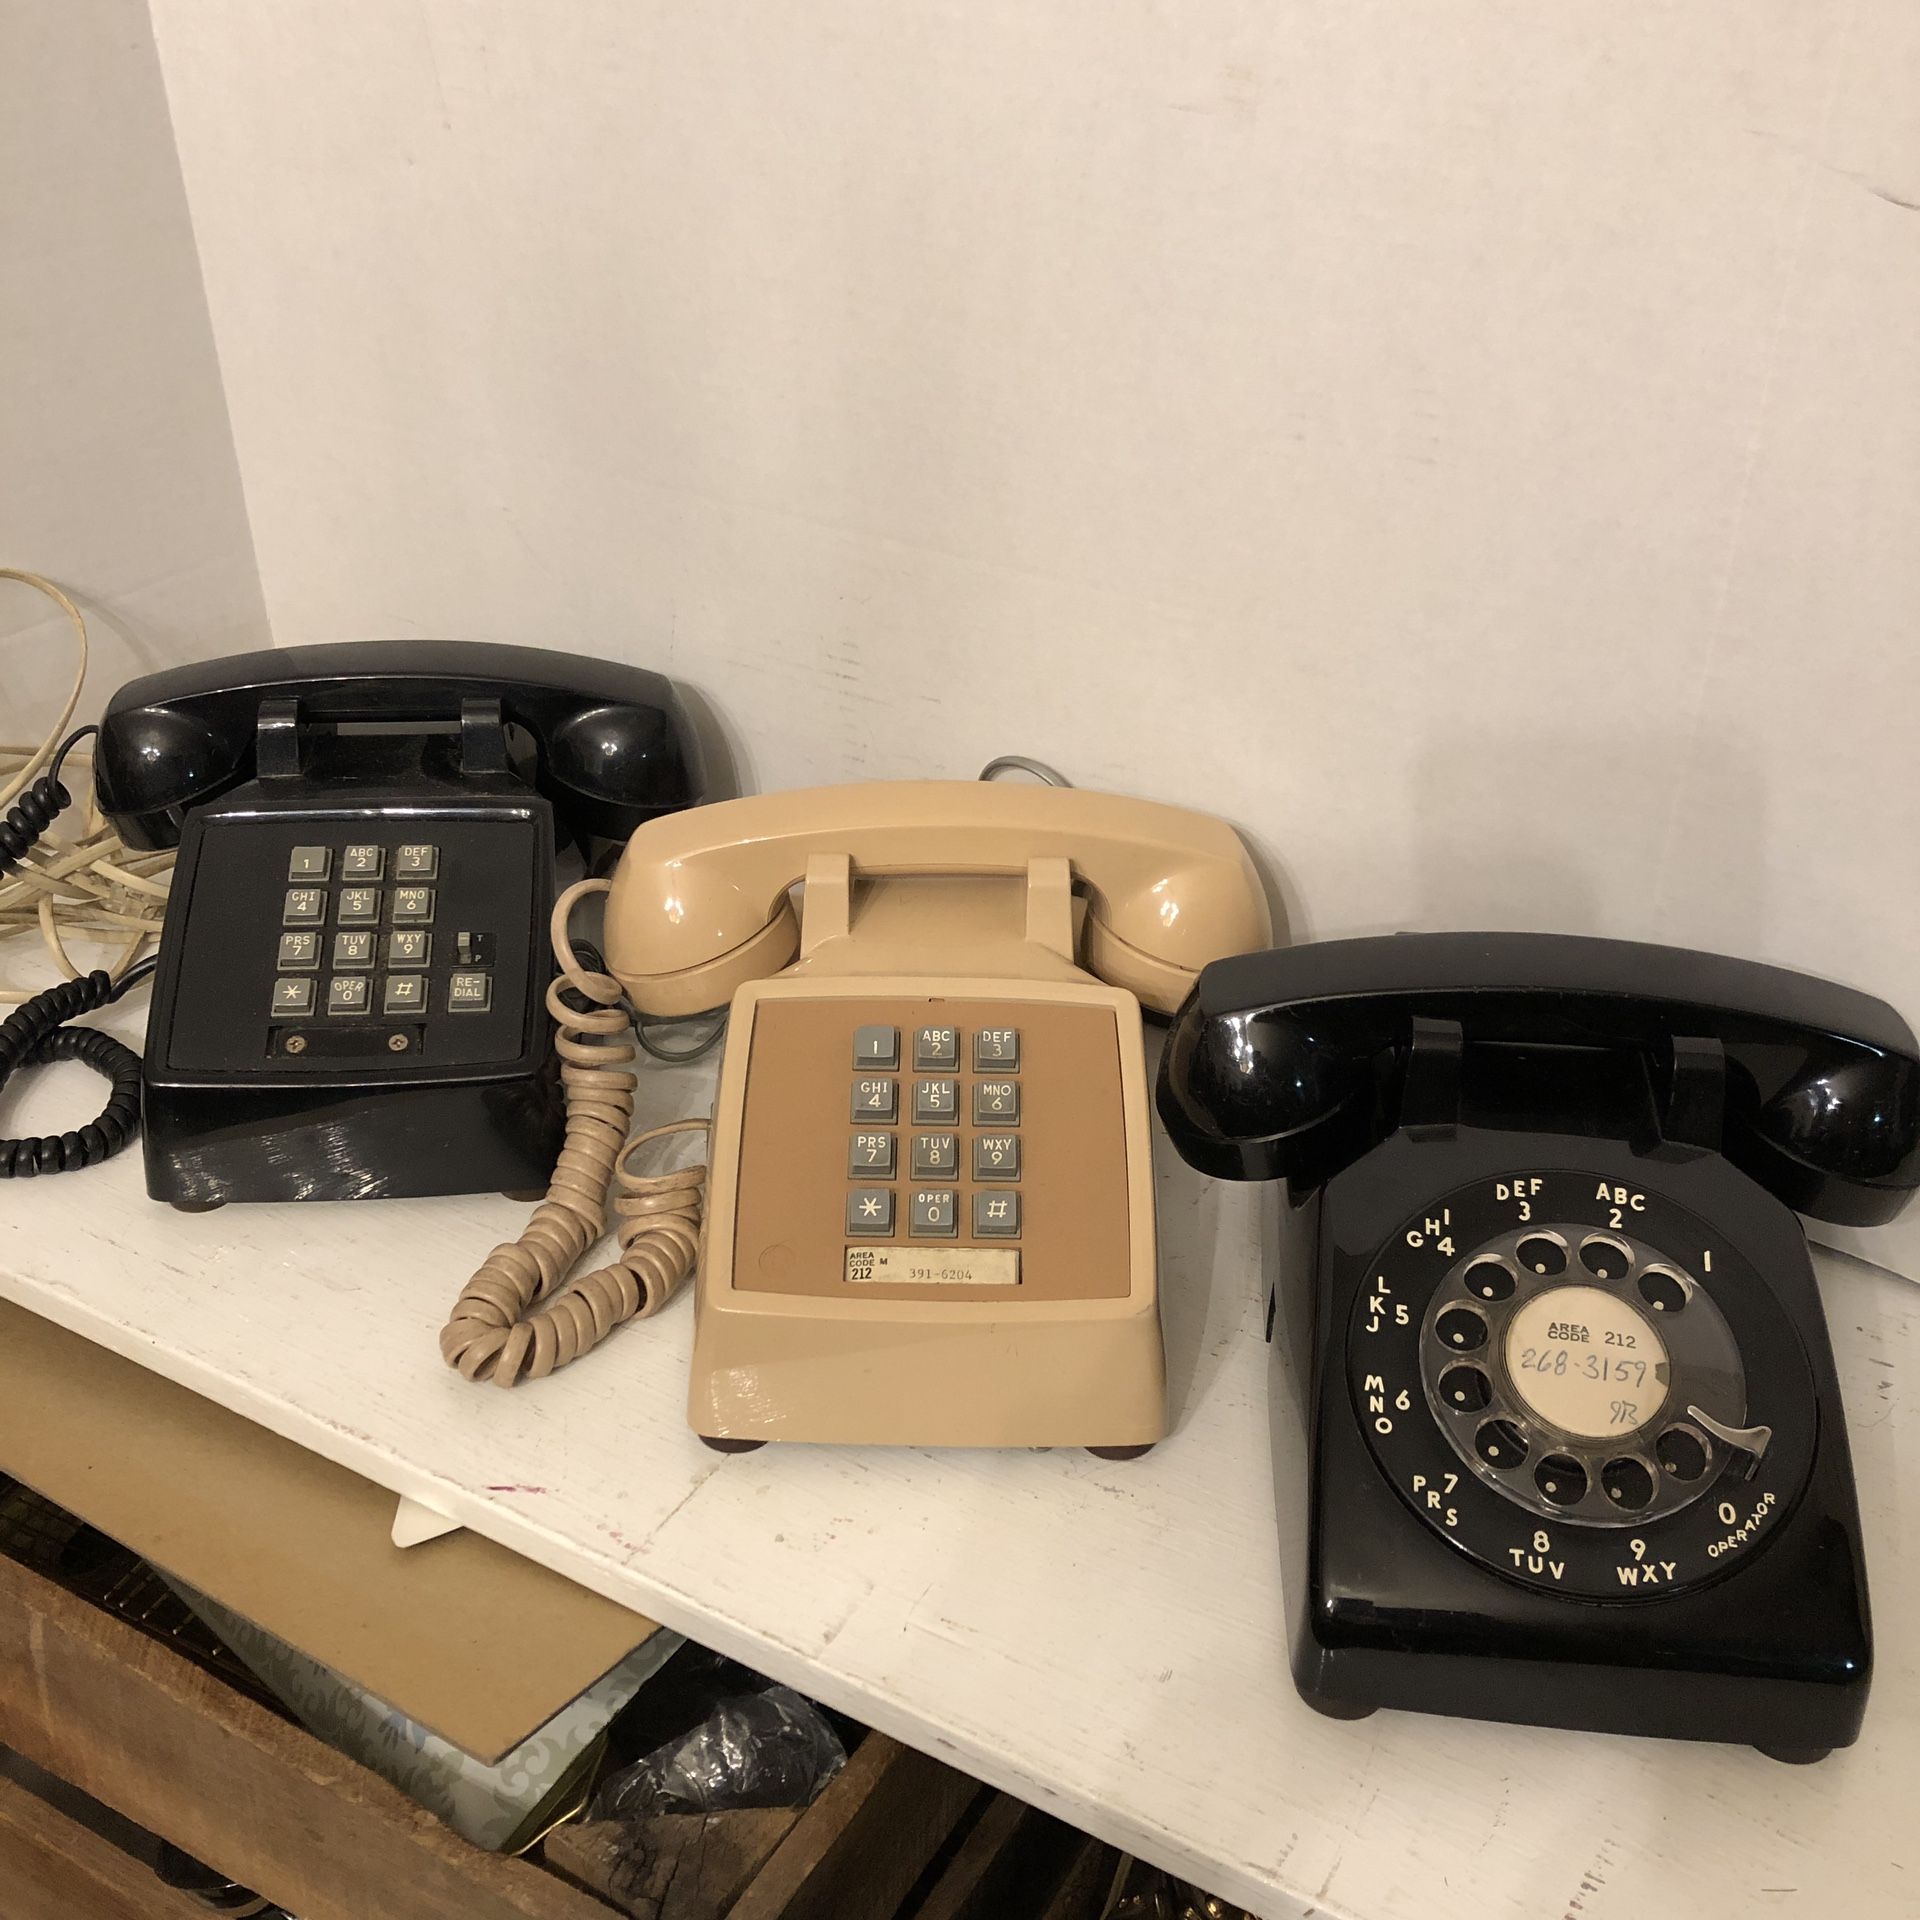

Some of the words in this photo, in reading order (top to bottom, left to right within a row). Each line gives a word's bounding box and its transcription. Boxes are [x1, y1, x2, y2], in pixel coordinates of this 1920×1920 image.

[350, 848, 373, 857] ABC
[404, 847, 428, 856] DEF
[304, 859, 309, 868] 1
[357, 858, 365, 867] 2
[412, 857, 420, 867] 3
[292, 892, 315, 901] GHI
[346, 891, 370, 900] JKL
[400, 891, 425, 900] MNO
[297, 902, 306, 911] 4
[353, 901, 362, 910] 5
[407, 900, 416, 909] 6
[286, 936, 310, 945] PRS
[342, 936, 367, 945] TUV
[397, 934, 422, 943] WXY
[293, 946, 302, 955] 7
[348, 946, 357, 955] 8
[404, 944, 413, 954] 9
[334, 981, 364, 992] OPER
[395, 982, 413, 995] #
[456, 978, 480, 987] RE-
[343, 991, 352, 1001] 0
[454, 988, 480, 997] DIAL
[922, 1030, 950, 1041] ABC
[983, 1031, 1012, 1042] DEF
[873, 1040, 878, 1054] 1
[931, 1043, 942, 1056] 2
[993, 1043, 1002, 1056] 3
[861, 1082, 888, 1093] GHI
[922, 1082, 950, 1094] JKL
[984, 1084, 1011, 1096] MNO
[869, 1094, 881, 1107] 4
[930, 1095, 940, 1108] 5
[992, 1097, 1001, 1110] 6
[857, 1136, 886, 1148] PRS
[921, 1137, 950, 1149] TUV
[983, 1138, 1012, 1150] WXY
[867, 1150, 877, 1163] 7
[930, 1152, 940, 1165] 8
[992, 1152, 1002, 1165] 9
[1496, 1179, 1543, 1200] DEF
[918, 1194, 949, 1203] OPER
[1596, 1183, 1645, 1211] ABC
[928, 1207, 939, 1222] 0
[987, 1201, 1007, 1218] #
[1519, 1202, 1531, 1221] 3
[1609, 1209, 1622, 1228] 2
[1406, 1209, 1450, 1248] GHI
[1437, 1238, 1455, 1256] 4
[850, 1259, 875, 1267] CODE
[1703, 1250, 1711, 1272] 1
[852, 1268, 872, 1280] 212
[909, 1268, 972, 1280] 391-6204
[1395, 1304, 1409, 1325] 5
[1547, 1322, 1590, 1336] AREA
[1547, 1330, 1590, 1344] CODE
[1604, 1331, 1637, 1349] 212
[1395, 1390, 1410, 1410] 6
[1444, 1473, 1459, 1494] 7
[1719, 1503, 1736, 1525] 0
[1707, 1493, 1775, 1558] OPERATOR
[1534, 1531, 1550, 1552] 8
[1630, 1539, 1645, 1560] 9
[1509, 1548, 1565, 1580] TUV
[1617, 1562, 1677, 1586] WXY
